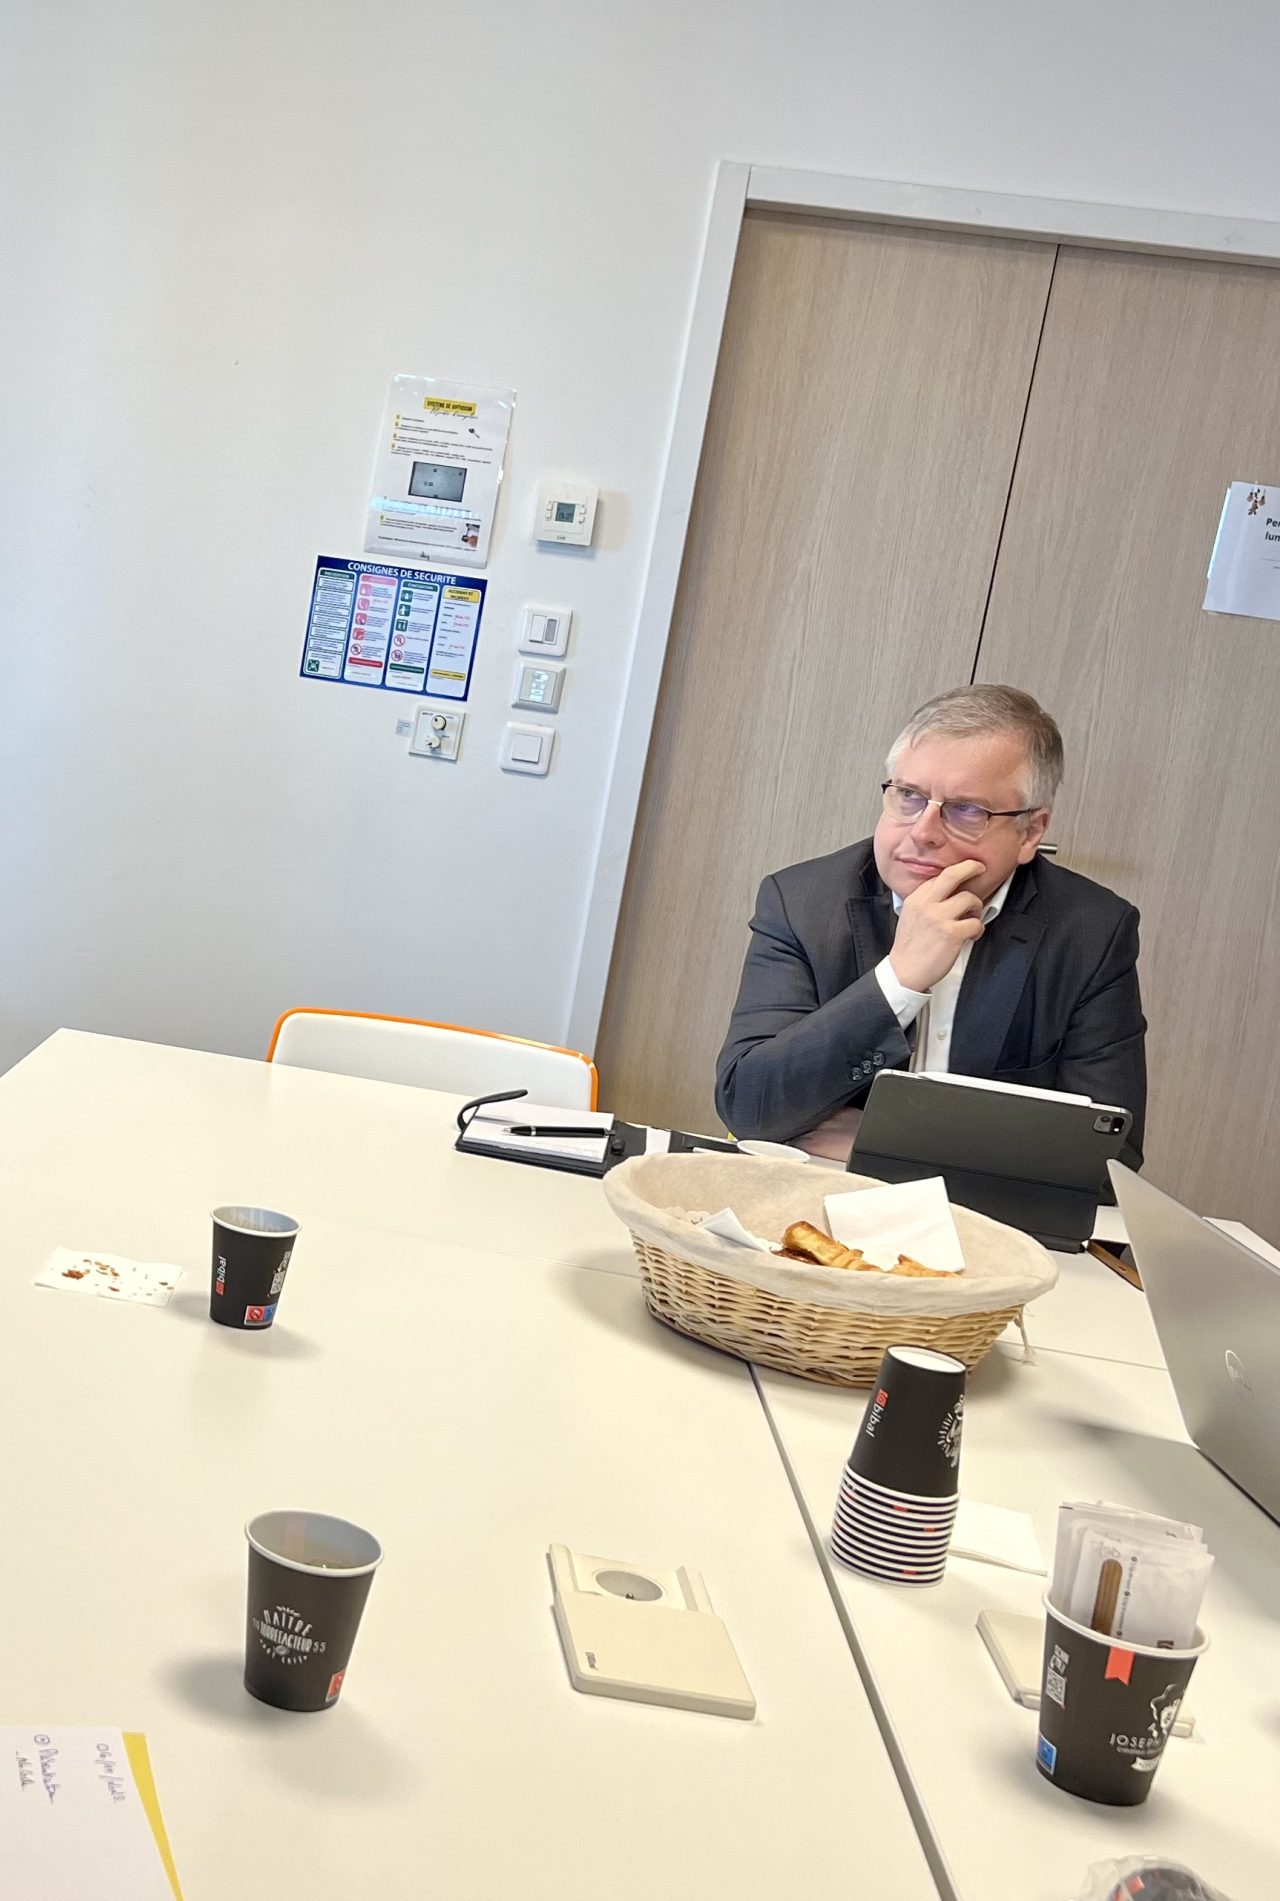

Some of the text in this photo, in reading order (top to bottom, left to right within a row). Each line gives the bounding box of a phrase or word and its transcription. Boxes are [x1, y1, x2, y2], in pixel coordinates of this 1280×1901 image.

[347, 561, 457, 585] CONSIGNES DE SECURITE
[216, 1255, 227, 1284] bibal
[865, 1402, 885, 1438] bibal
